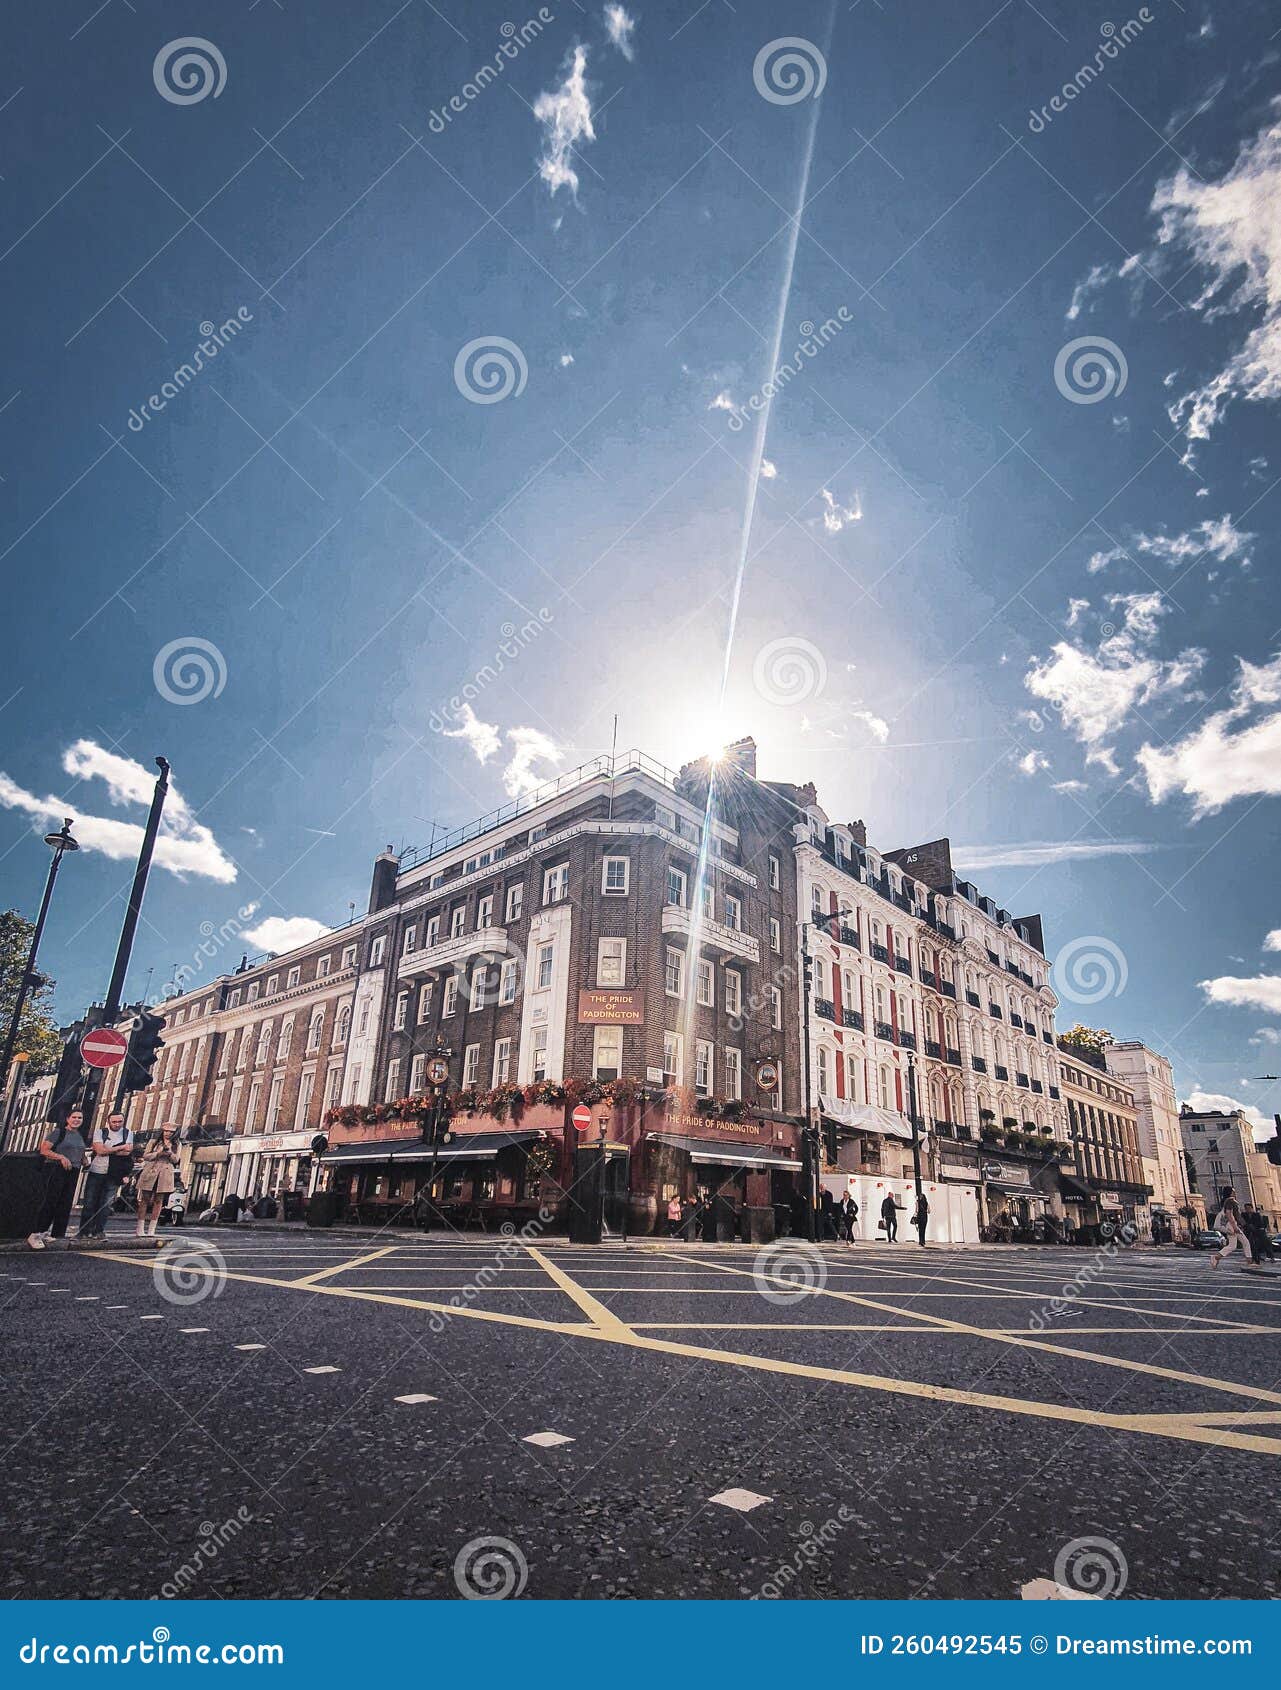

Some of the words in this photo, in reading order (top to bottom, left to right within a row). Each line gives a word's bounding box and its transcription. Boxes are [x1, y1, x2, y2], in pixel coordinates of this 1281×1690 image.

[906, 853, 918, 864] AS
[590, 995, 607, 1003] THE
[609, 995, 633, 1003] PRIDE
[583, 1010, 639, 1019] PADDINGTON
[664, 1112, 680, 1124] THE
[682, 1115, 703, 1127] PRIDE
[705, 1119, 715, 1129] OF
[716, 1120, 760, 1135] PADDINGTON
